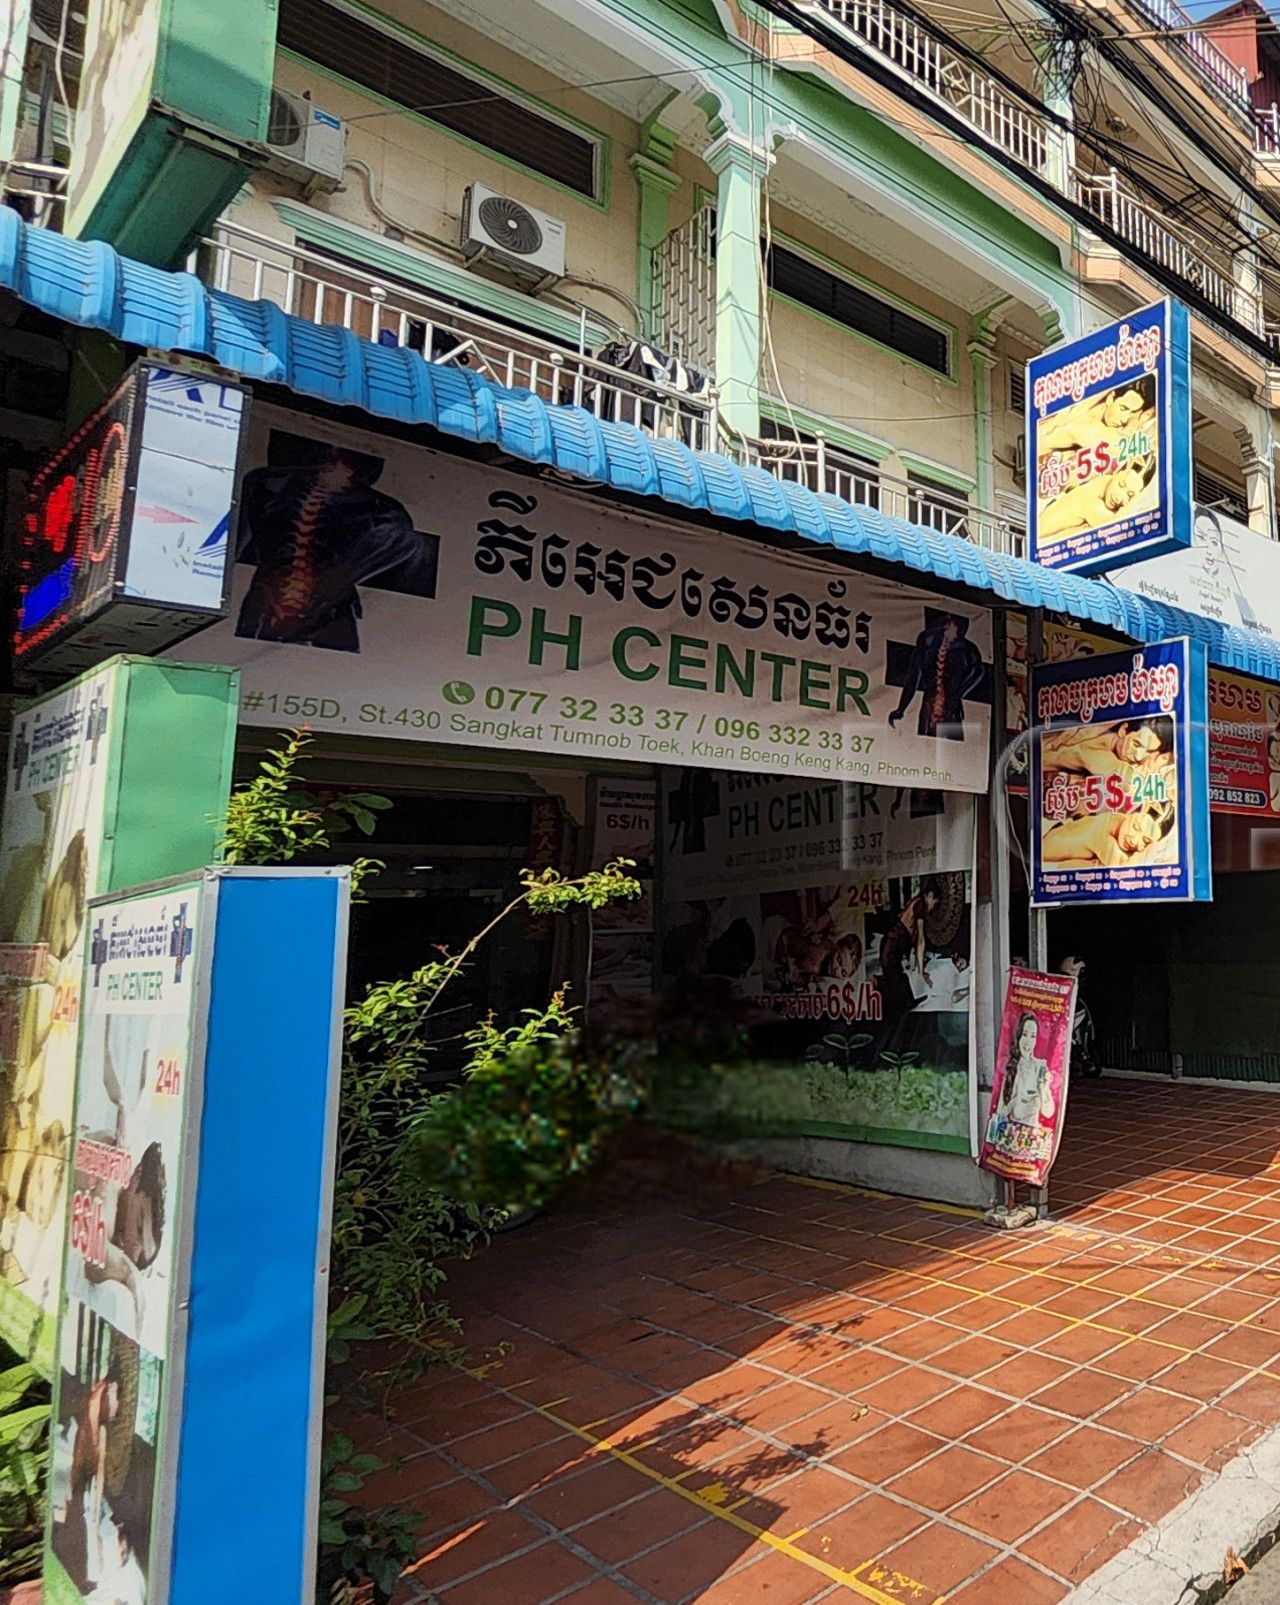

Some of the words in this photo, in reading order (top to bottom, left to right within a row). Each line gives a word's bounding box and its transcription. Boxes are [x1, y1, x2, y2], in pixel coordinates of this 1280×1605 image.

[1076, 440, 1111, 481] 5$
[1118, 430, 1150, 464] 24h
[474, 490, 873, 654] ភីអេជសេនធ័រ
[466, 595, 582, 672] PH
[612, 626, 872, 716] CENTER
[242, 692, 347, 723] #155D,
[358, 703, 442, 730] St.430
[449, 714, 544, 741] Sangkat
[550, 724, 631, 749] Tumnob
[638, 733, 685, 756] Toek,
[691, 740, 735, 761] Khan
[739, 746, 790, 767] Boeng
[794, 753, 831, 773] Keng
[877, 762, 920, 778] Phnom
[923, 766, 955, 783] Penh.
[485, 686, 549, 716] 077
[559, 696, 599, 722] 32
[608, 703, 645, 727] 33
[654, 709, 689, 733] 37
[697, 714, 706, 735] /
[714, 717, 760, 741] 096
[768, 724, 810, 747] 332
[818, 730, 843, 750] 33
[850, 735, 875, 755] 37
[1084, 773, 1126, 815] 5$
[1132, 773, 1167, 805] 24h
[606, 814, 650, 831] 6$/h
[728, 801, 760, 840] PH
[768, 783, 881, 832] CENTER
[852, 835, 866, 850] 33
[869, 832, 884, 848] 37
[847, 881, 884, 909] 24h
[122, 970, 163, 1001] CENTER
[826, 981, 884, 1026] 6$/h
[156, 1058, 181, 1097] 24h
